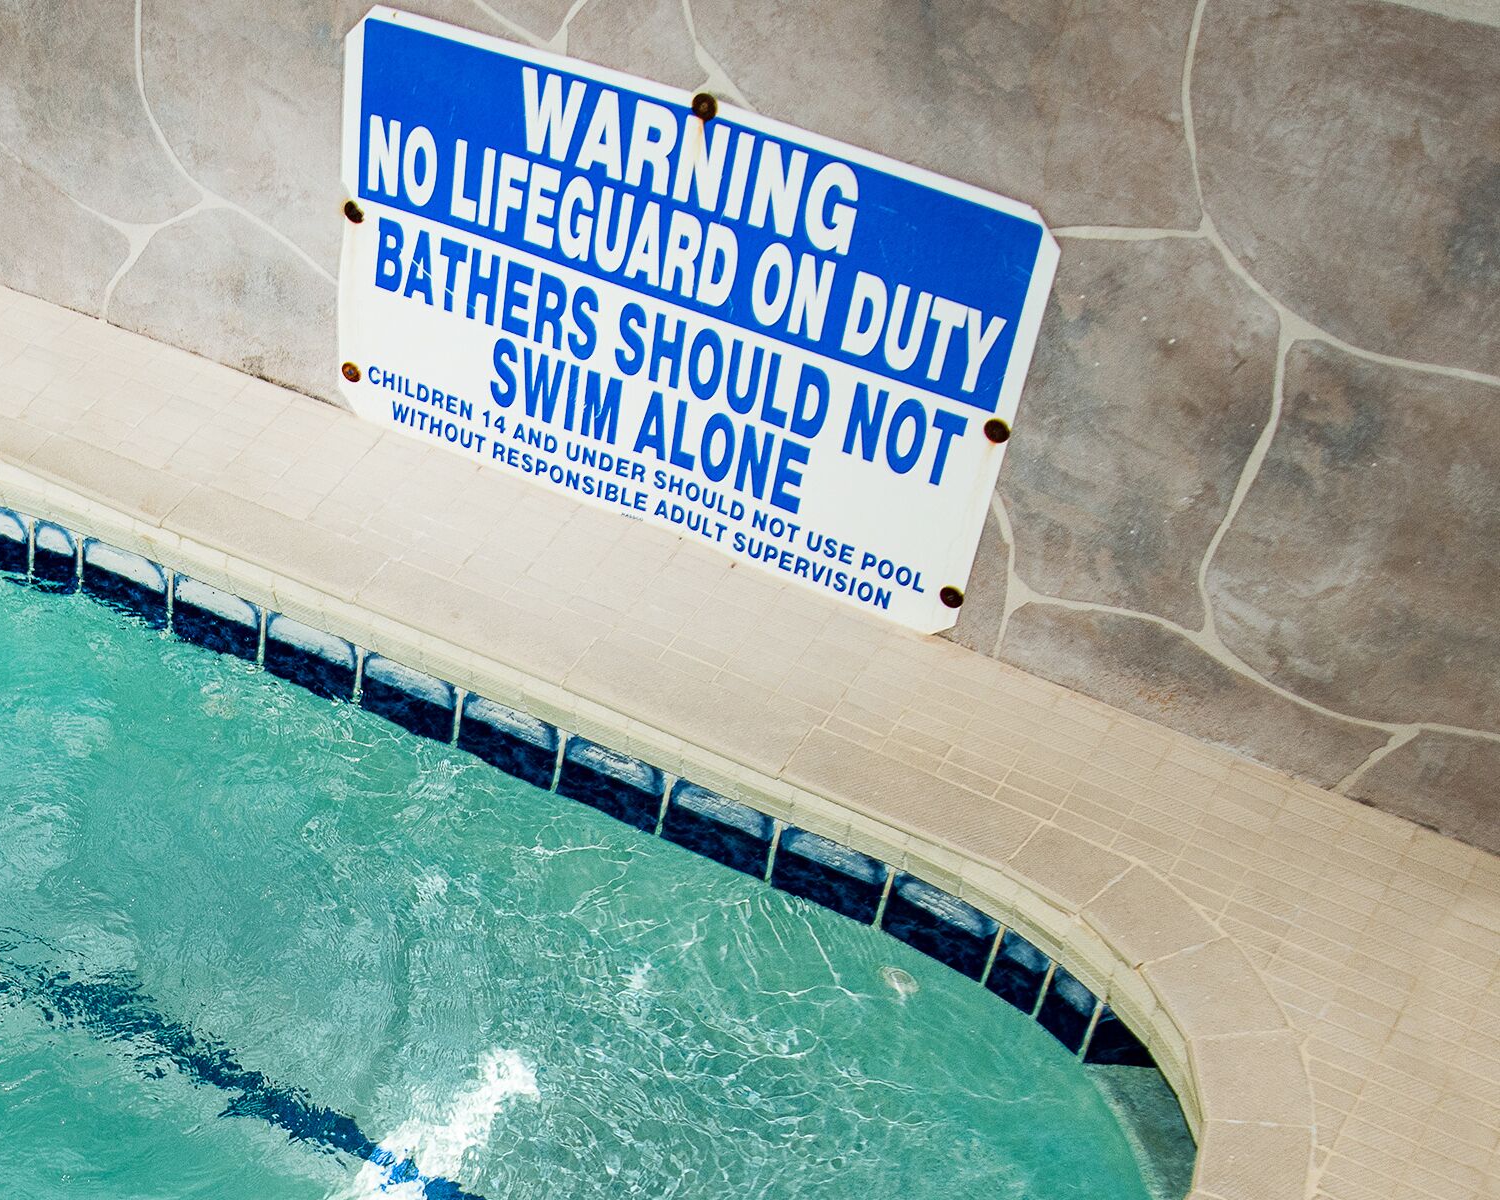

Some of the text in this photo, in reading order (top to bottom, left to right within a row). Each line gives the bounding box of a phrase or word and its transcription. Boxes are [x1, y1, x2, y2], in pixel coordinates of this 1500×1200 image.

[367, 114, 1007, 393] NO LIFEGUARD ON DUTY
[522, 66, 859, 256] WARNING
[375, 216, 969, 486] BATHERS SHOULD NOT
[490, 337, 811, 515] SWIM ALONE
[367, 365, 925, 593] CHILDREN 14 AND UNDER SHOULD NOT USE POOL
[391, 400, 892, 610] WITHOUT RESPONSIBLE ADULT SUPERVISION
